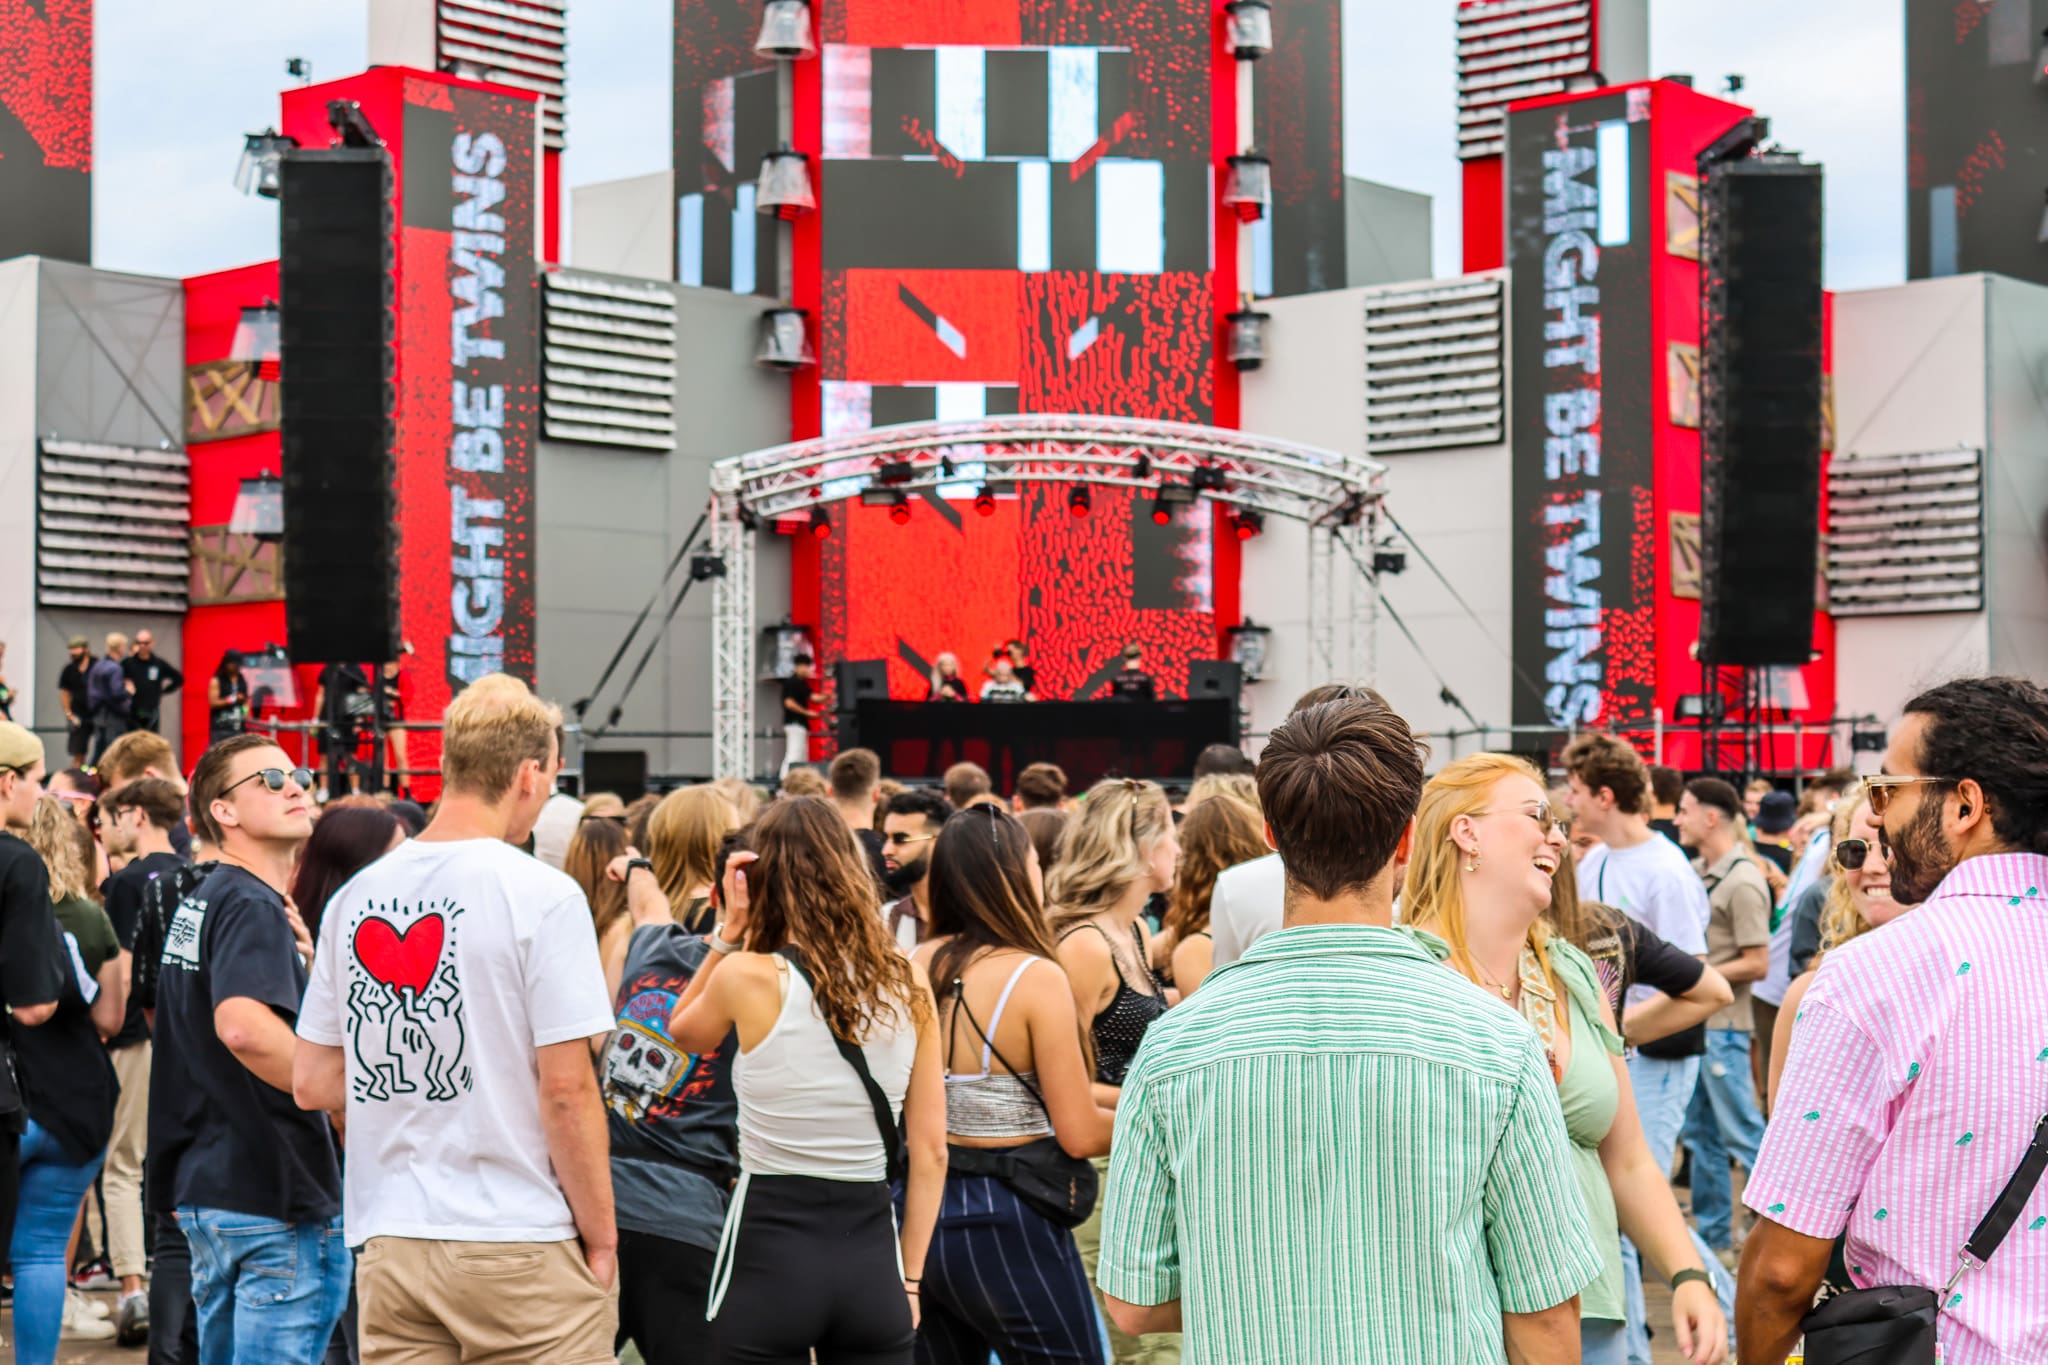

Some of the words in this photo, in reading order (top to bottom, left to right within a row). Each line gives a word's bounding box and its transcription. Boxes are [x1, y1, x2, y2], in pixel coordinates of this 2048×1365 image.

[450, 132, 507, 367] TWINS
[1542, 146, 1600, 374] MIGHT
[451, 380, 505, 473] BE
[1544, 388, 1601, 481] BE
[1544, 488, 1601, 727] TWINS
